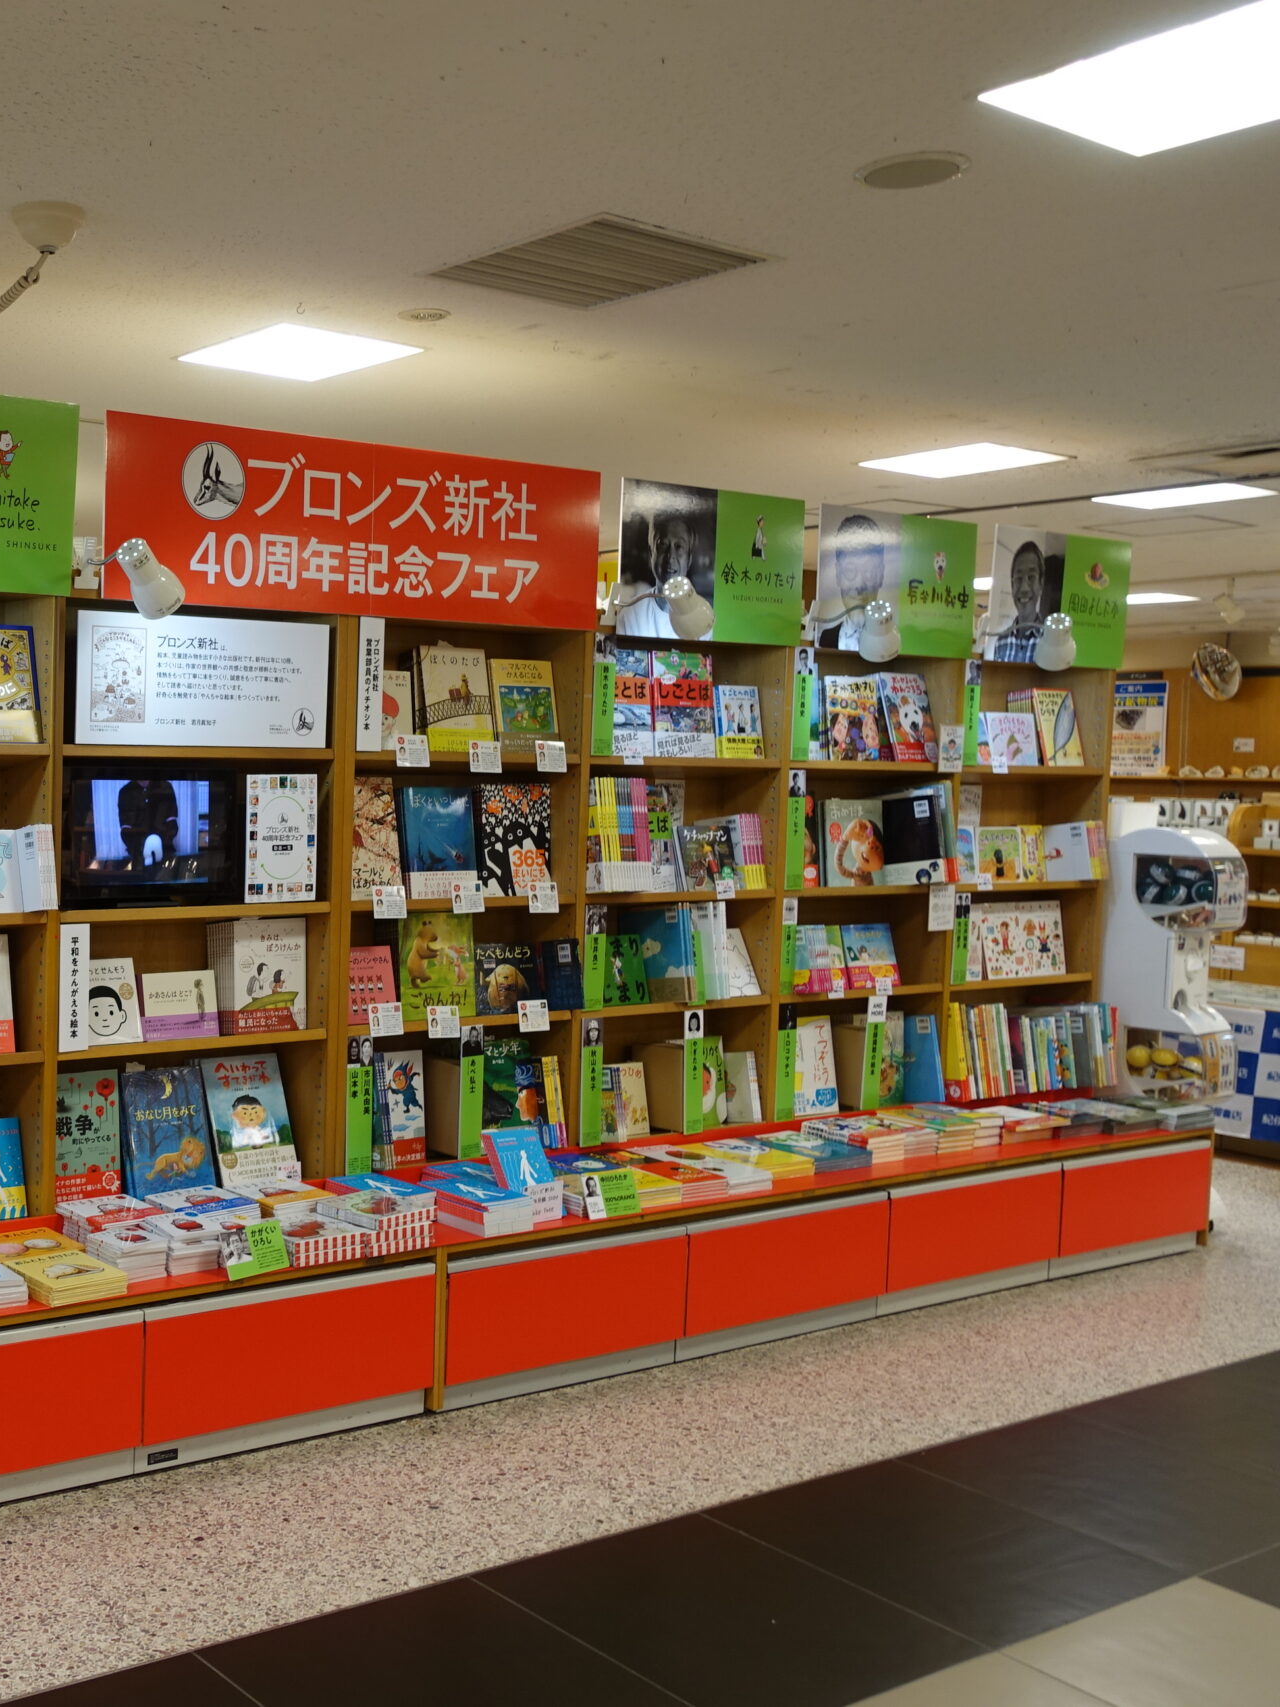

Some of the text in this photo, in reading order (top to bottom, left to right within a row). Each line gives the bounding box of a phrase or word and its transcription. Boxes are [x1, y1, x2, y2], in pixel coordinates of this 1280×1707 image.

[248, 452, 538, 541] ブロンズ新社
[6, 539, 58, 552] SHINSUKE
[190, 532, 540, 603] 40周年記念フェア
[721, 561, 796, 589] 鈴木のりたけ
[430, 654, 480, 666] ぼくのたび
[658, 683, 710, 700] しごとば
[512, 850, 546, 867] 365
[476, 948, 531, 960] たべもんどう
[70, 937, 79, 1039] 平和をかんがえる絵本
[409, 989, 467, 1009] ごめんね!
[214, 1060, 267, 1074] へいわって
[134, 1105, 196, 1122] おなじ月をみて
[250, 1224, 277, 1239] かがくい
[252, 1234, 272, 1246] ひろし
